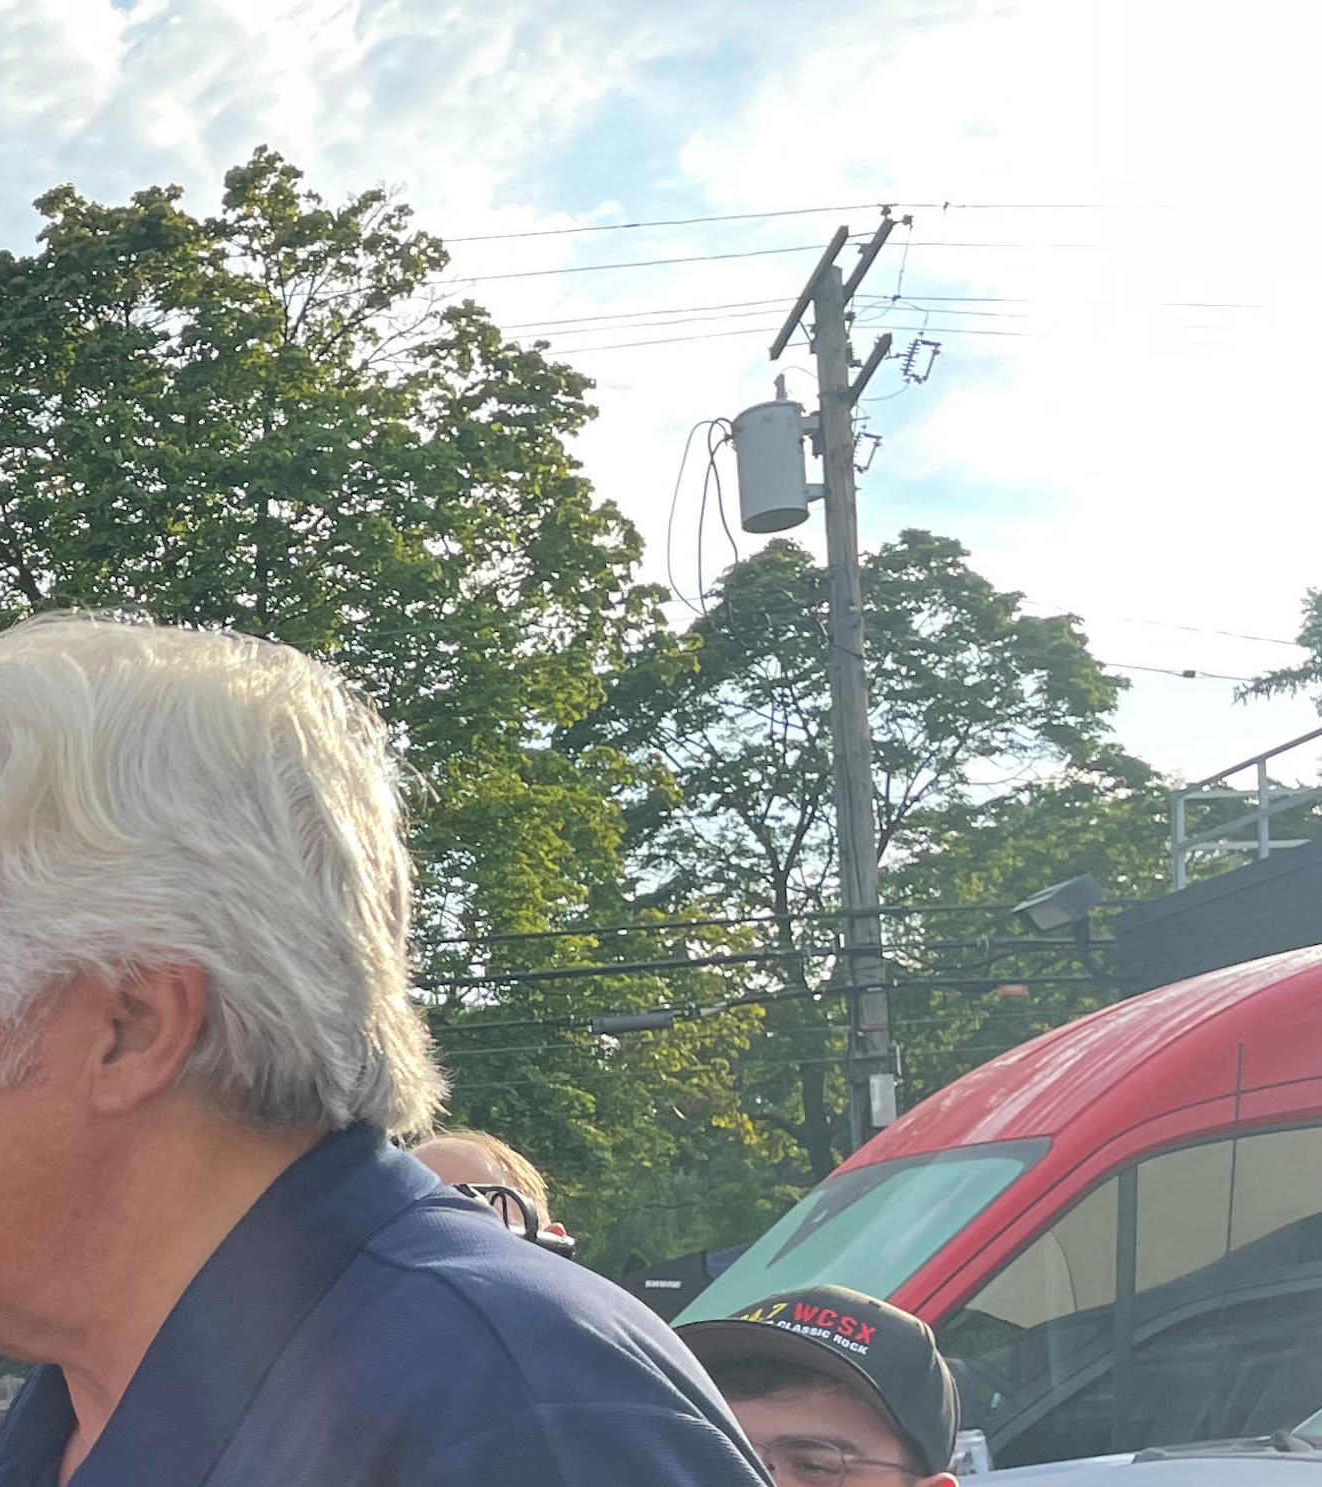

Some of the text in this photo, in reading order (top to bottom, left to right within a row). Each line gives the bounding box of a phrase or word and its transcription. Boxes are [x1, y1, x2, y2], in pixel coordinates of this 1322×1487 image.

[776, 1320, 869, 1355] CLASSIC ROCK
[793, 1302, 875, 1345] WCSX
